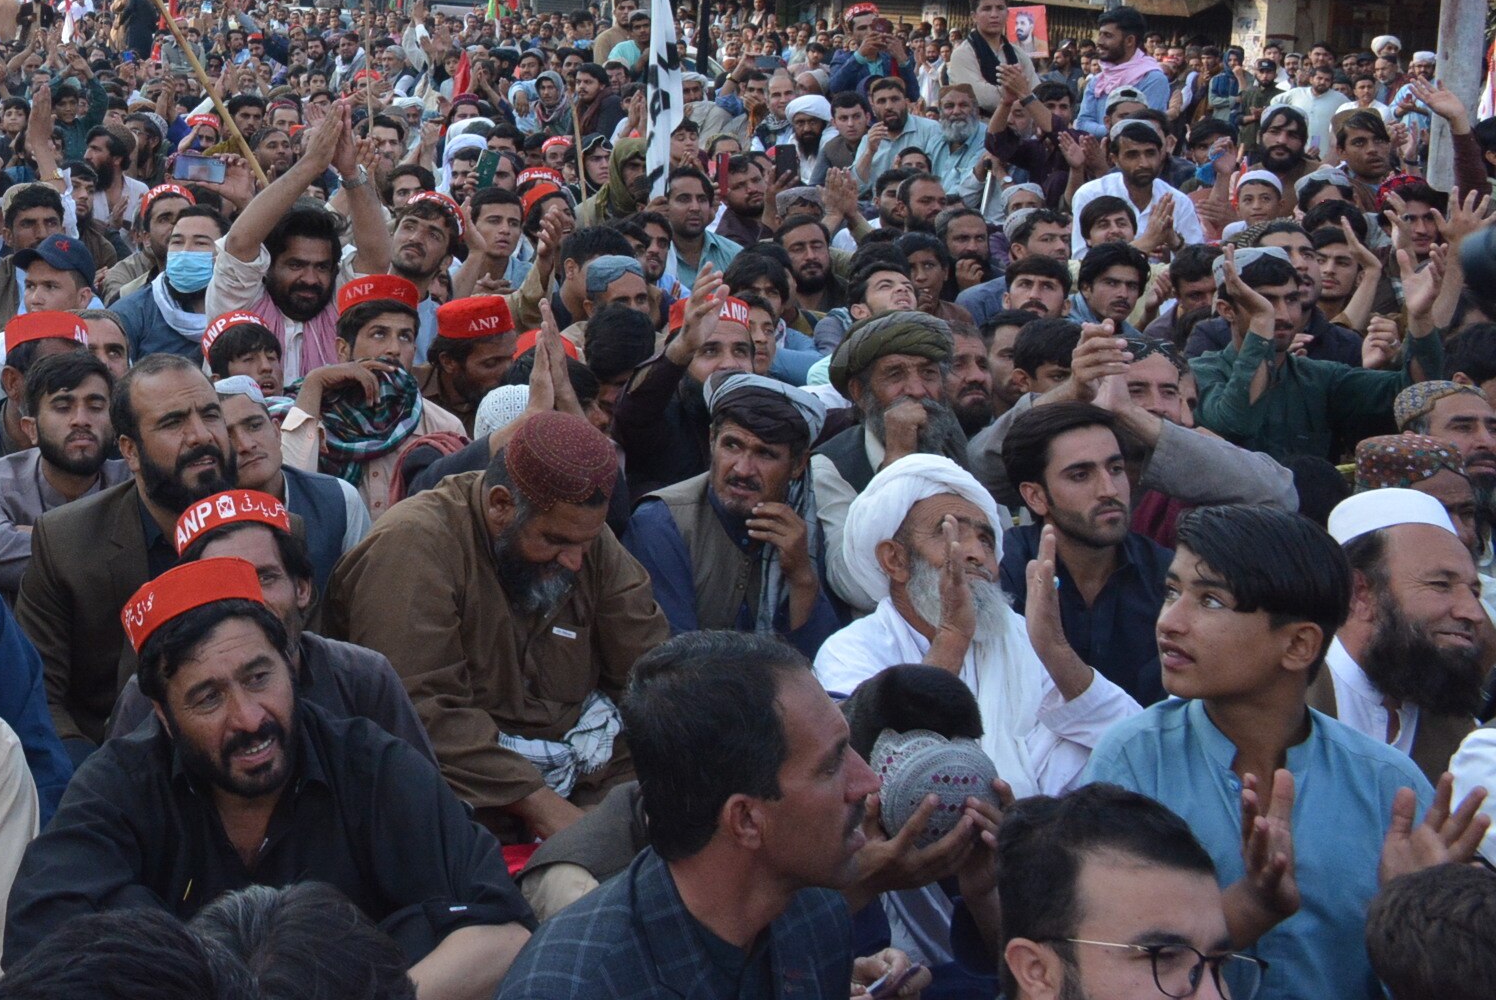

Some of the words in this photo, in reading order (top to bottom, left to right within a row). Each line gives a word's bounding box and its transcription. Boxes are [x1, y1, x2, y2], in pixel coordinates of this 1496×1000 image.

[147, 184, 171, 203] ANP
[345, 283, 375, 301] ANP
[719, 301, 748, 323] ANP
[202, 318, 227, 349] ANP
[468, 316, 500, 332] ANP
[176, 502, 213, 551] ANP
